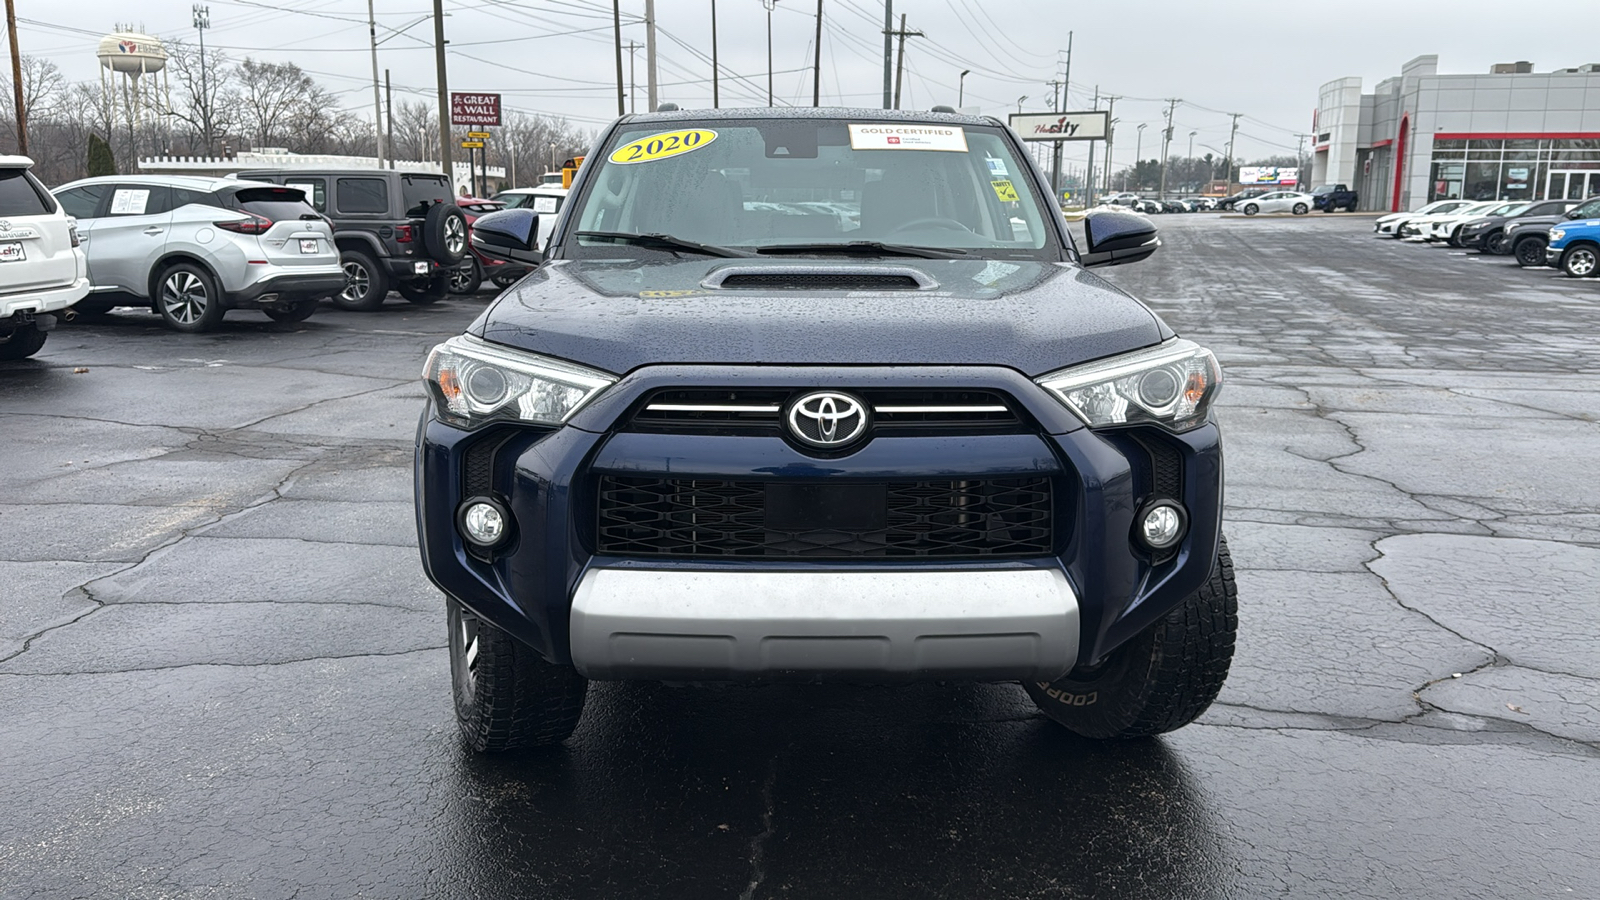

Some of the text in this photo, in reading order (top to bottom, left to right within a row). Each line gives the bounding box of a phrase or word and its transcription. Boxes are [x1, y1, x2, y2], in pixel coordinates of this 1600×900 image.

[463, 95, 496, 105] GREAT
[464, 105, 495, 115] WALL
[627, 132, 701, 161] 2020
